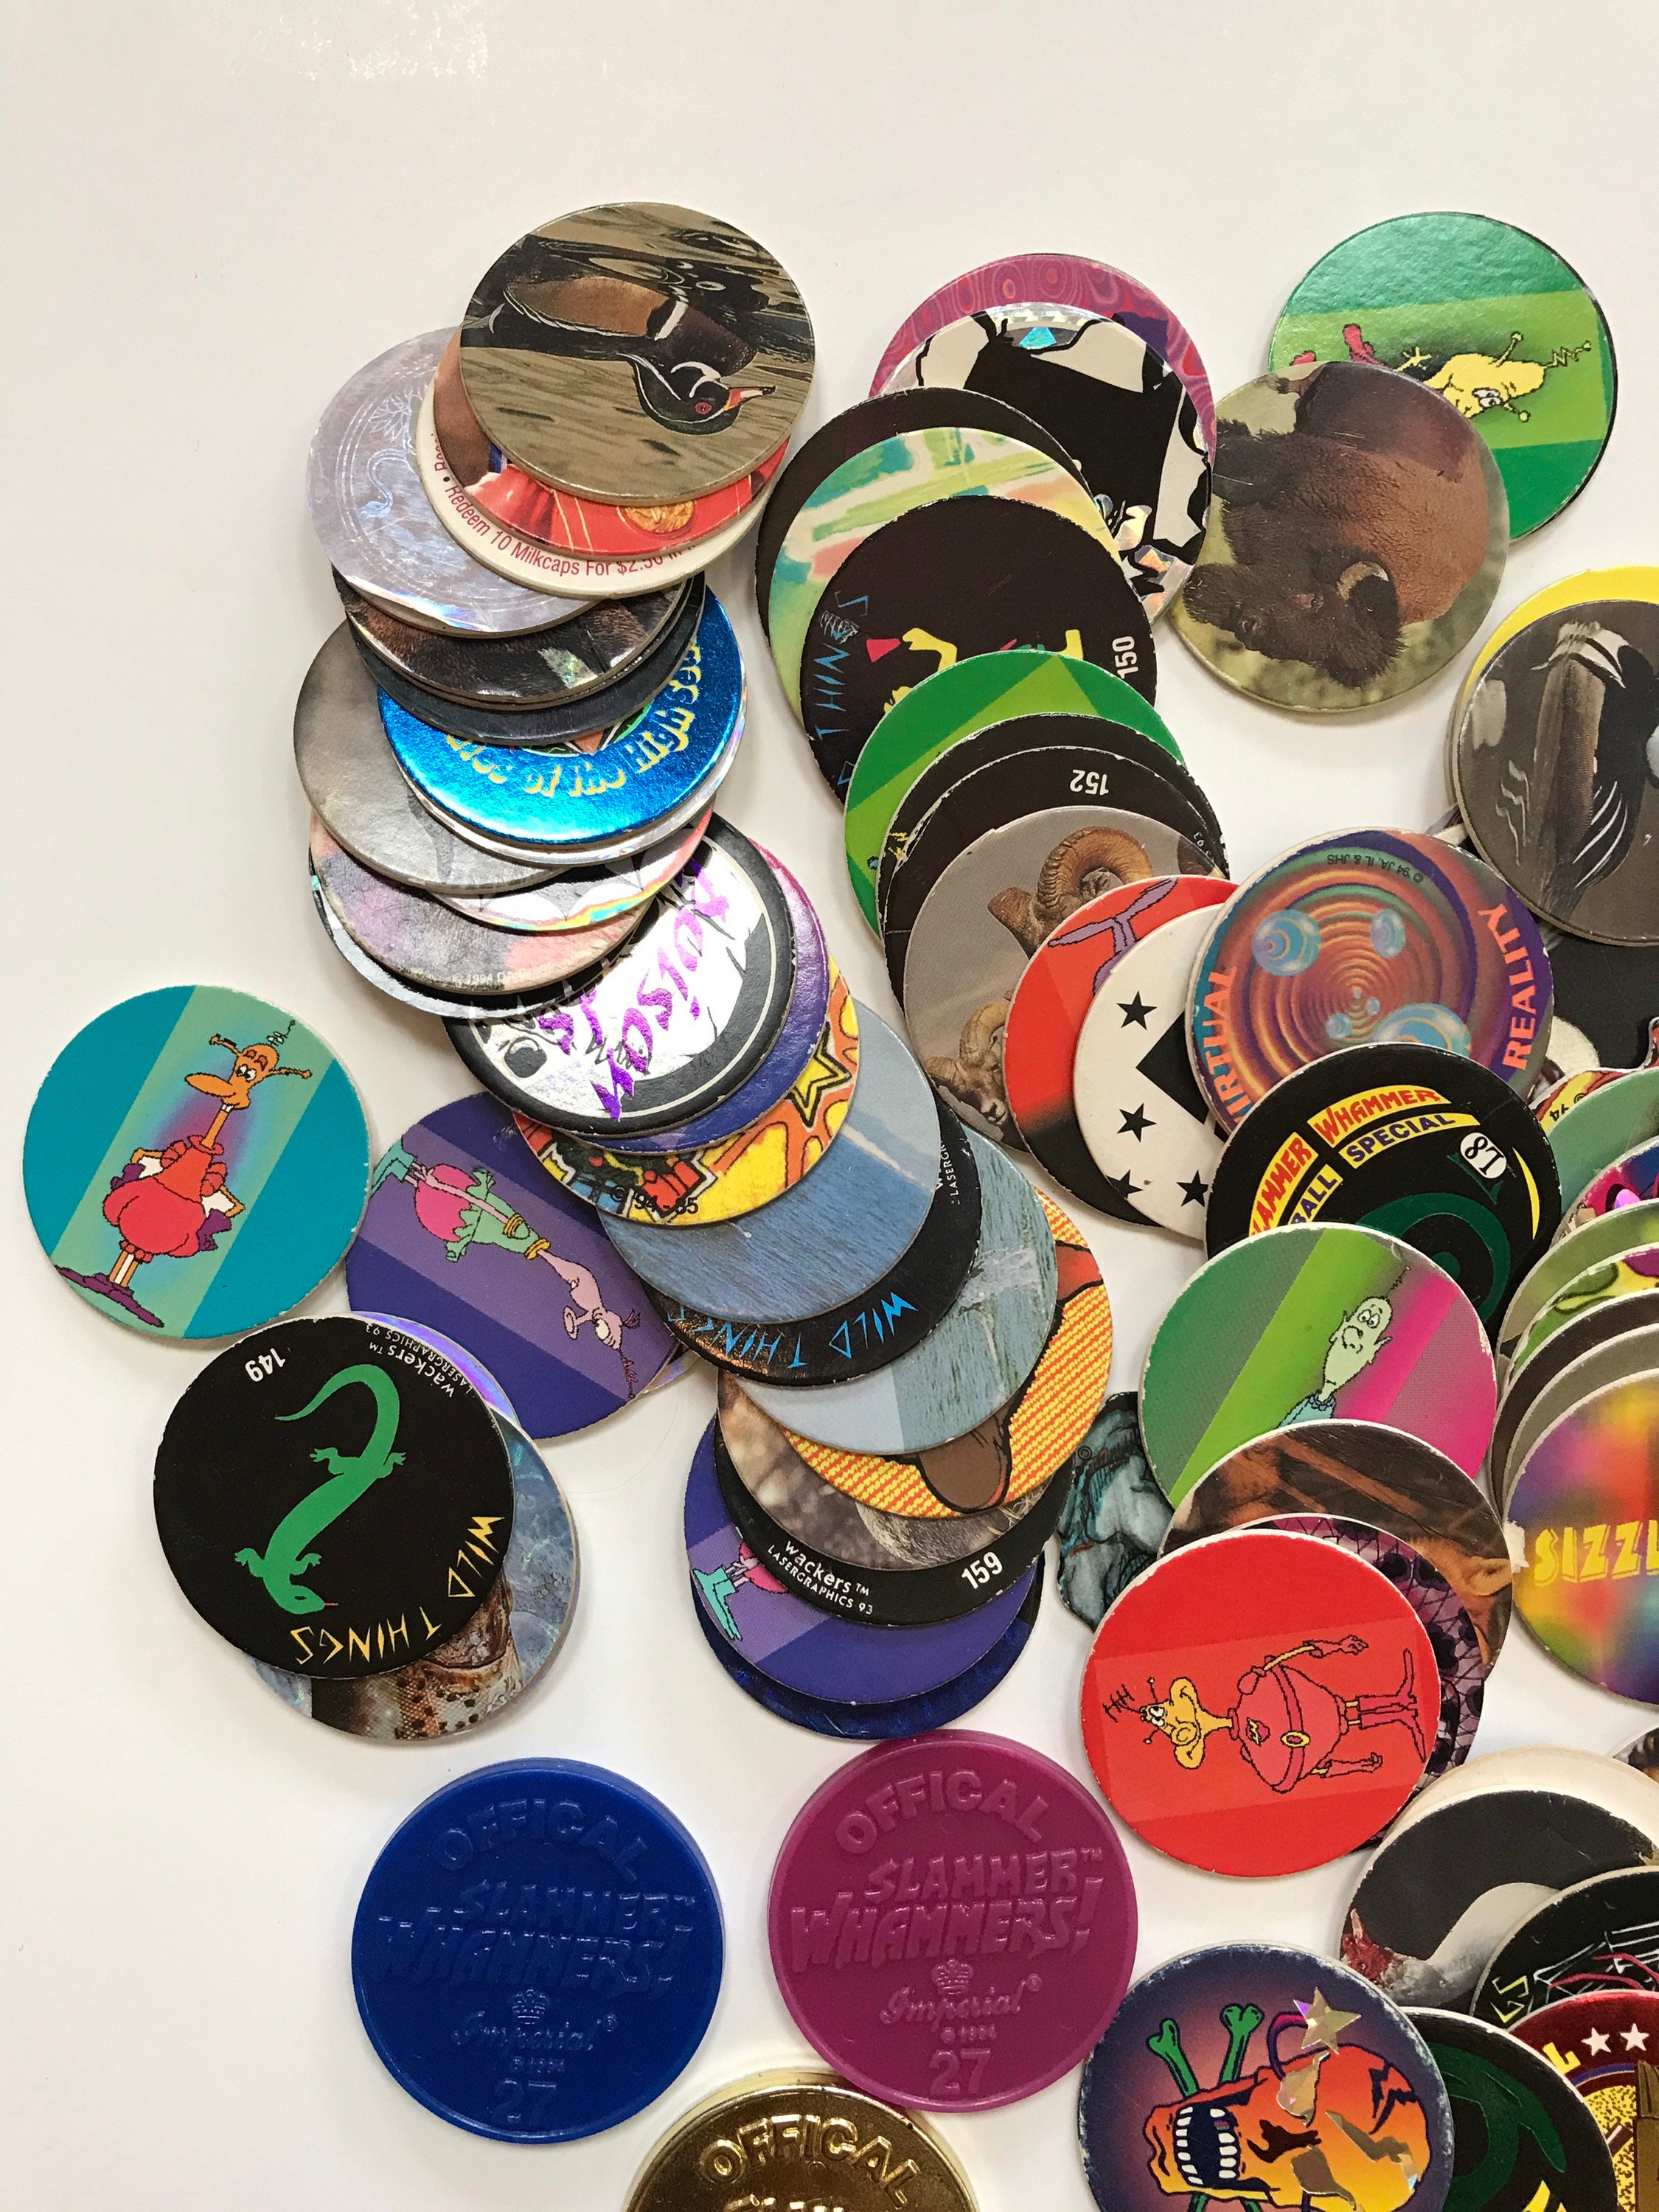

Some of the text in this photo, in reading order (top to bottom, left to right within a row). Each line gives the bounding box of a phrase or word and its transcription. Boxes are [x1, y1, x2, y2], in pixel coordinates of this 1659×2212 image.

[445, 484, 490, 538] Redeem
[490, 530, 513, 552] 10
[511, 541, 580, 577] Milkcaps
[586, 560, 612, 576] For
[1112, 636, 1139, 680] 150
[1068, 768, 1110, 797] 152
[1327, 853, 1351, 865] JHS
[1354, 854, 1362, 865] &
[1203, 903, 1537, 1123] IRTUAL REALITY
[1314, 1088, 1442, 1142] WHAMMER
[1347, 1113, 1456, 1163] SPECIAL
[830, 1291, 919, 1359] WILD
[244, 1347, 287, 1383] 149
[365, 1323, 473, 1395] LASERGRAPHICS 93
[387, 1344, 456, 1398] wackers
[290, 1516, 505, 1665] WILD THINGS
[767, 1545, 874, 1615] LASERGRAPHICS 93
[784, 1540, 852, 1591] wackers
[961, 1551, 1004, 1590] 159
[835, 1770, 1049, 1854] OFFICAL
[438, 1797, 648, 1882] OFFICAL
[864, 1848, 1078, 1904] SLAMMER
[791, 1877, 1104, 1973] WHAMMERS!
[929, 2048, 992, 2096] 27
[492, 2077, 557, 2125] 27
[699, 2113, 921, 2208] OFFICAL
